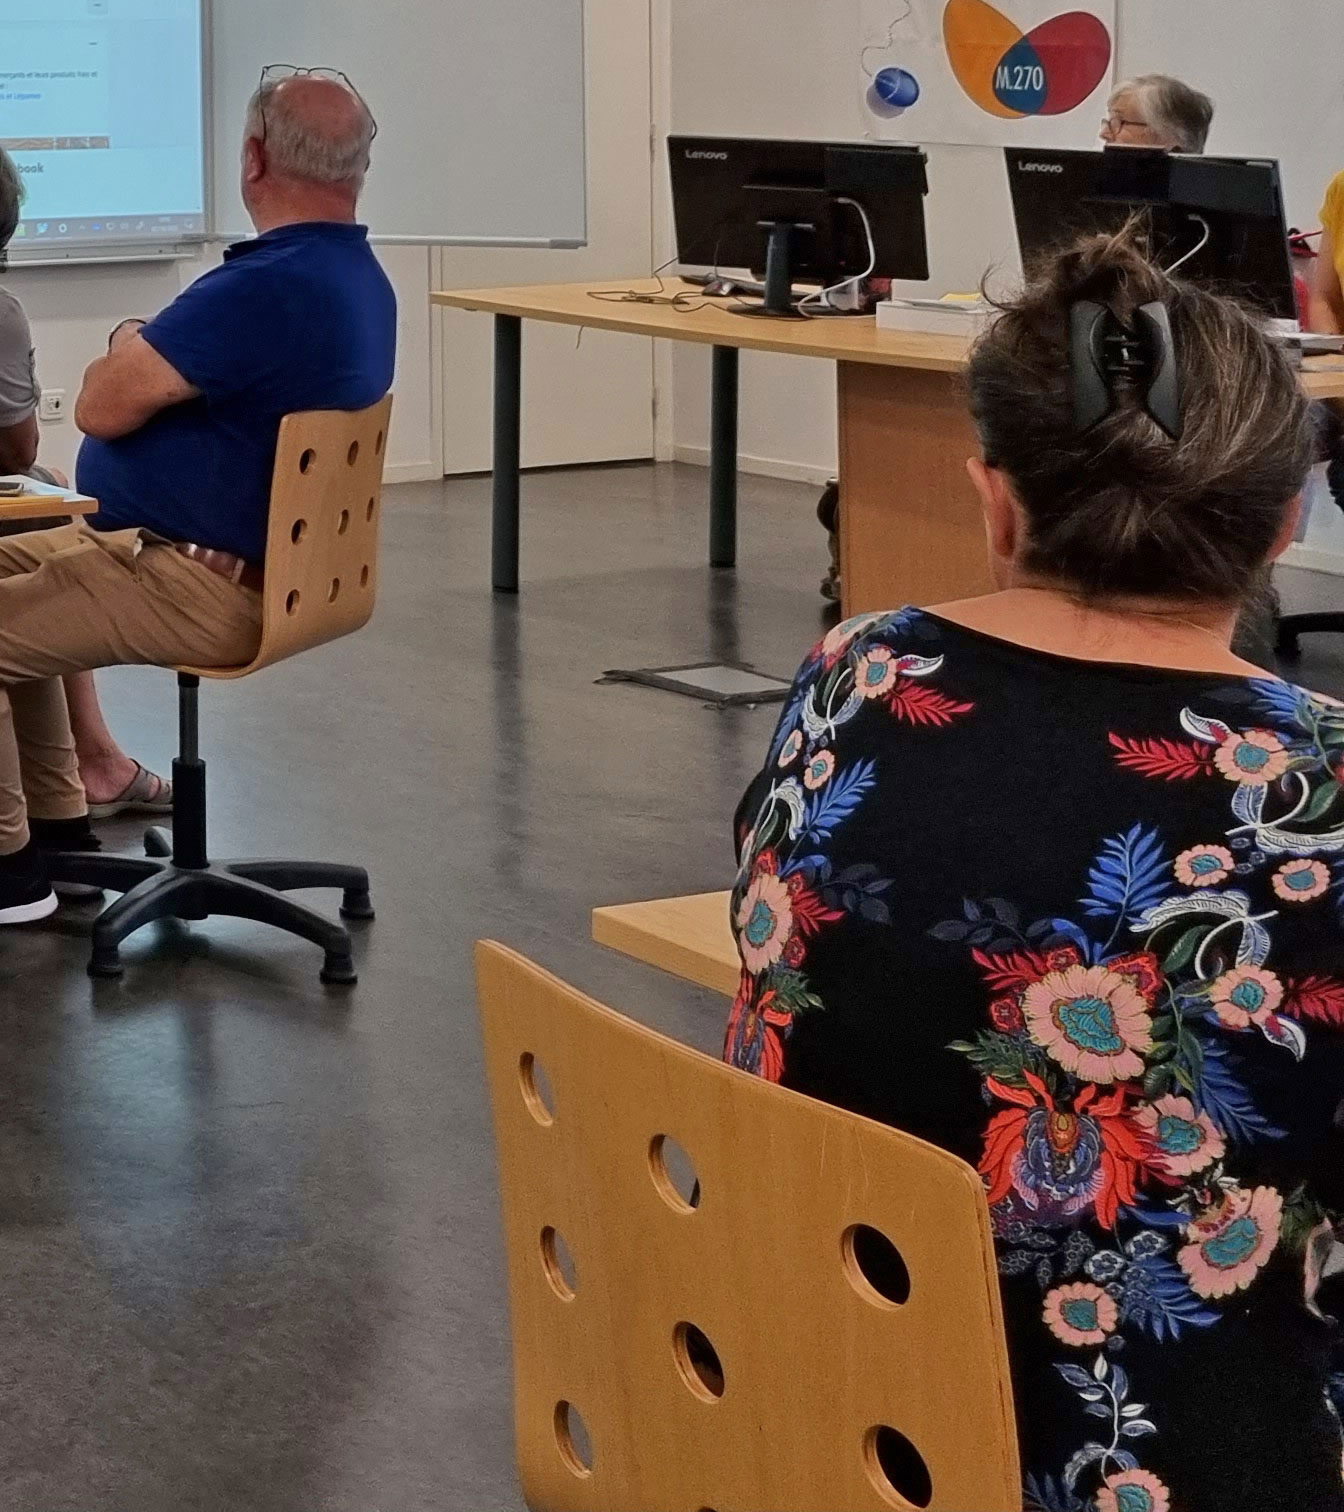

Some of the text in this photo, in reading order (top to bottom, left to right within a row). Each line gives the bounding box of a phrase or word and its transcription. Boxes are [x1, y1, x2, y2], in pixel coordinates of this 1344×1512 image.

[995, 65, 1044, 92] M.270
[685, 149, 728, 161] Lenovo
[1018, 161, 1063, 174] Lenovo
